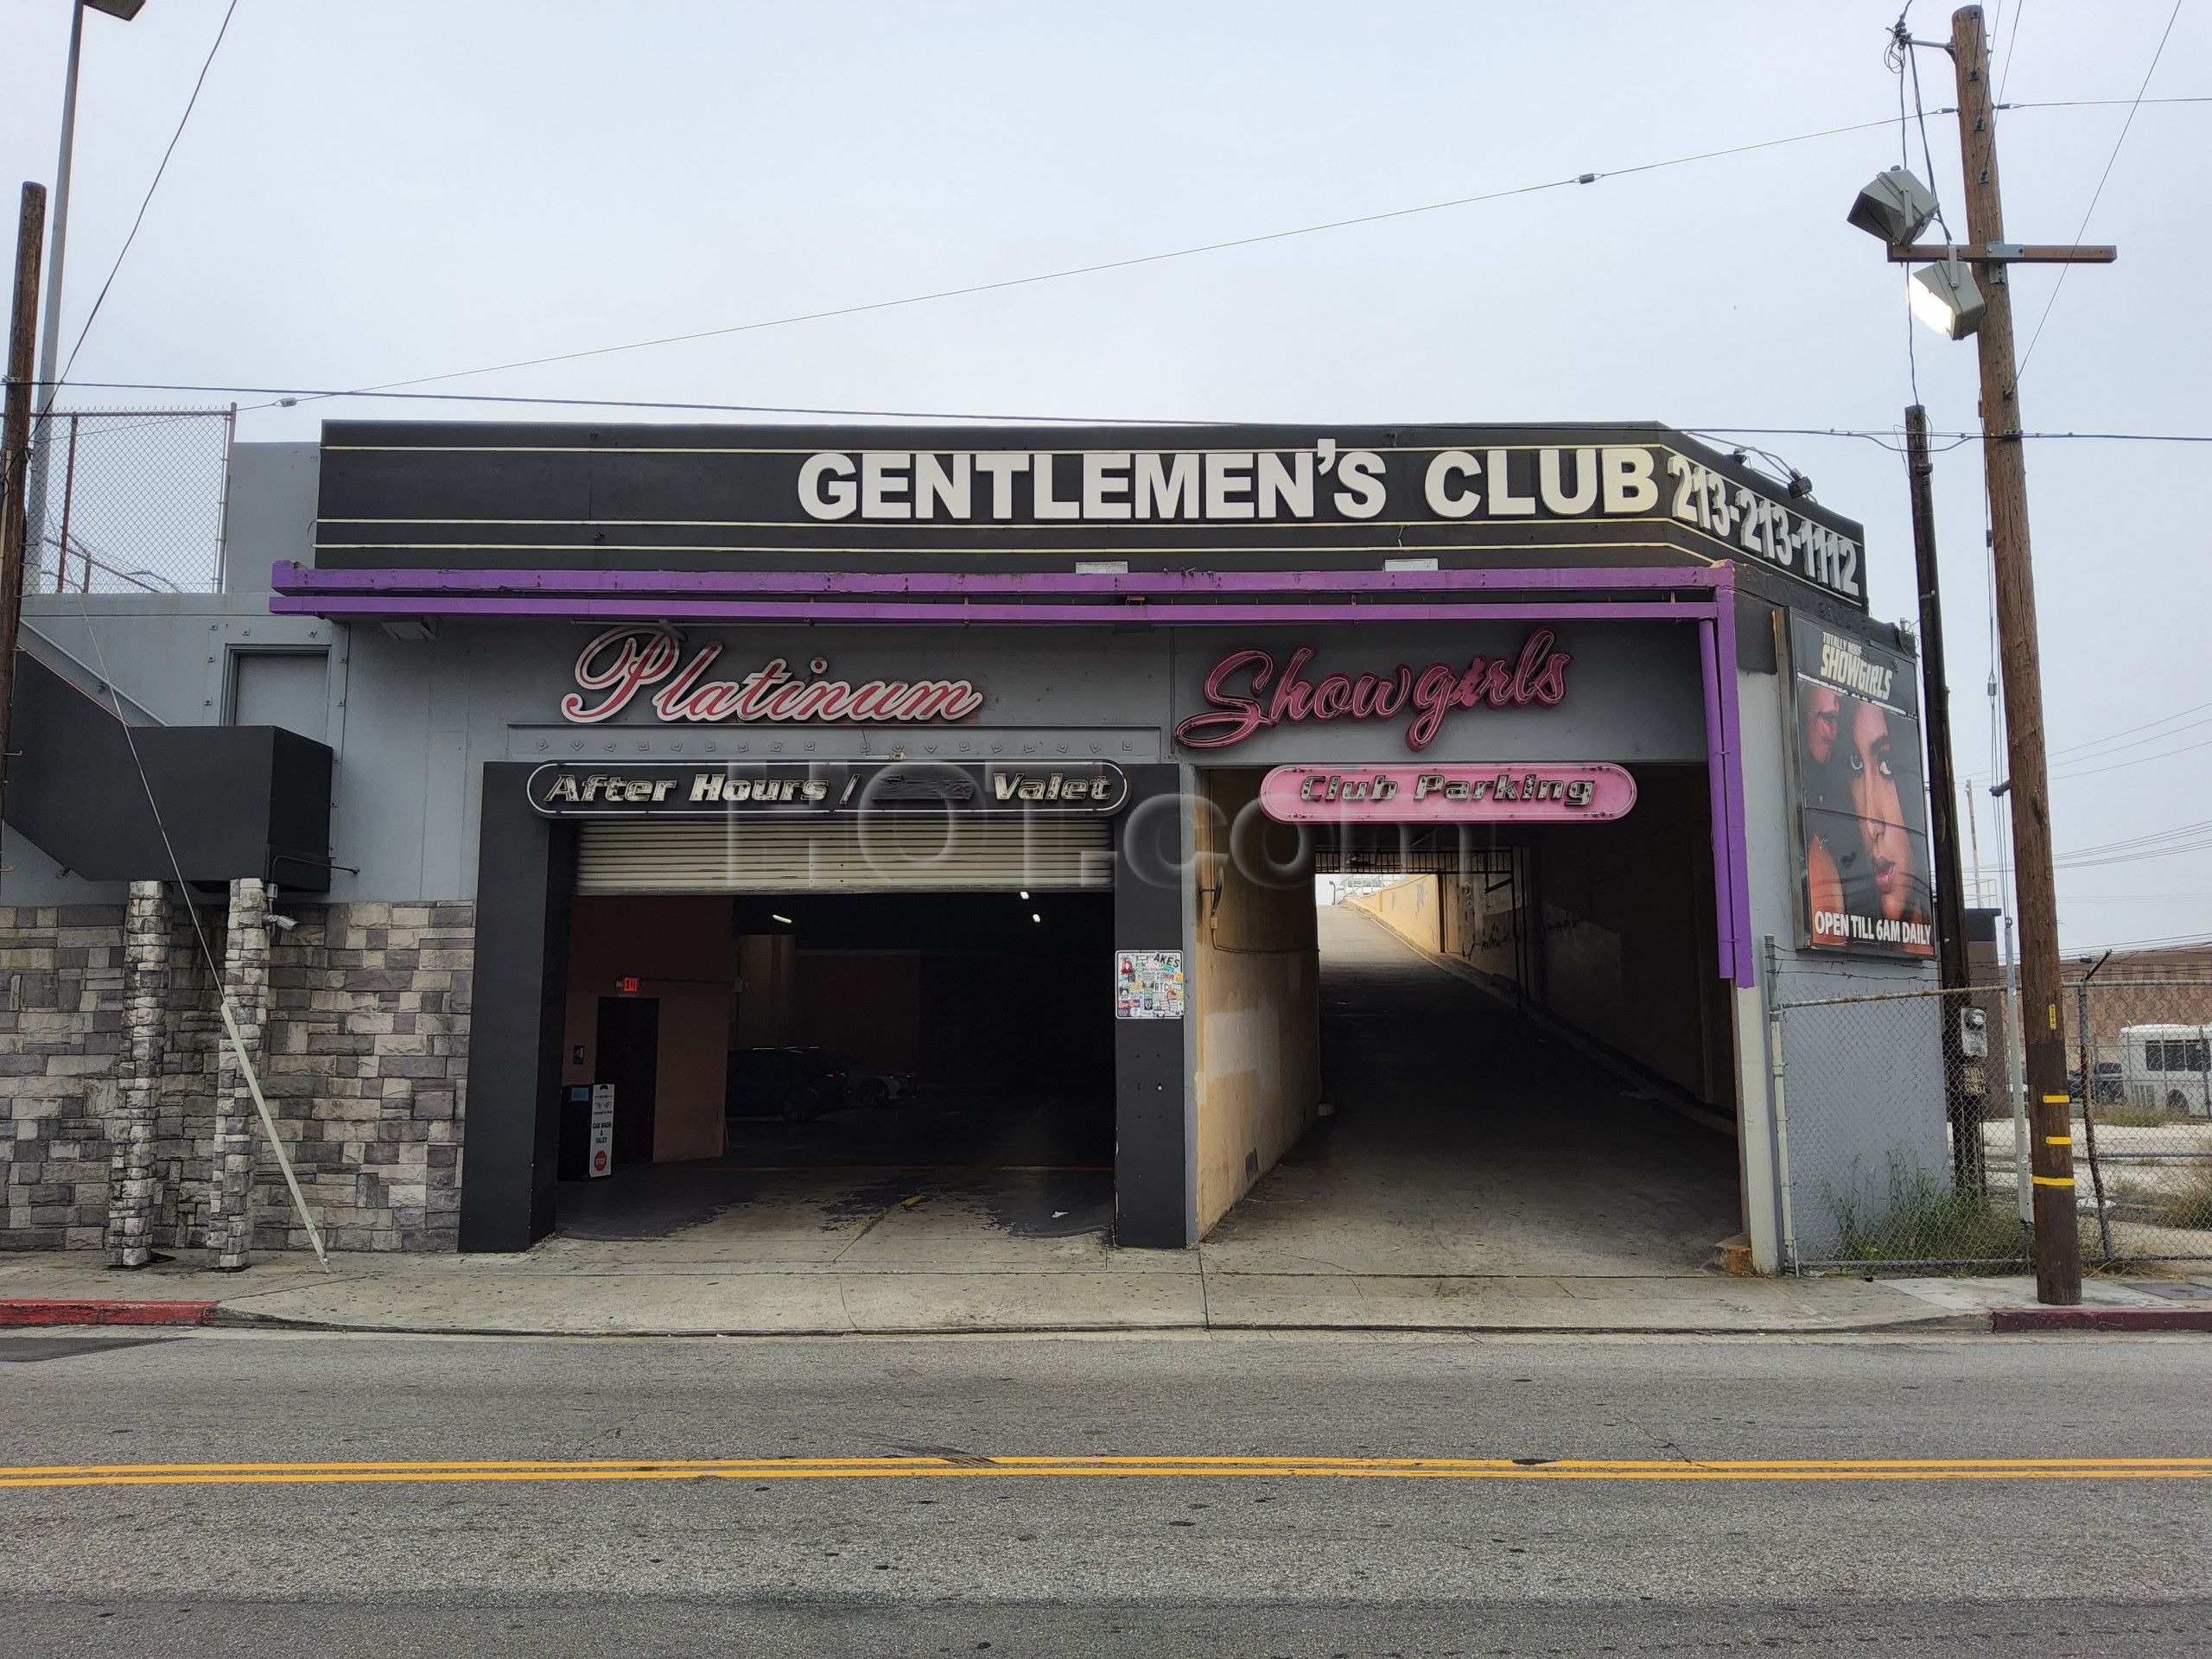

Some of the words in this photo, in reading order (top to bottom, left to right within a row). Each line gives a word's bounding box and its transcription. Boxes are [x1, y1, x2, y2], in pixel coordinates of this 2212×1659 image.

[798, 438, 1387, 519] GENTLEMEN'S
[1424, 447, 1659, 518] CLUB
[1667, 454, 1859, 597] 213-213-1112
[1822, 631, 1847, 651] TOTALLY
[561, 625, 983, 723] Platinum
[1173, 625, 1573, 751] Showgirls
[1821, 644, 1892, 701] SHOWGIRLS
[543, 774, 677, 803] After
[688, 773, 829, 802] Hours
[993, 772, 1111, 801] Valet
[1300, 775, 1398, 801] Club
[1412, 775, 1597, 806] Parking
[1815, 911, 1849, 937] OPEN
[1850, 915, 1874, 939] TILL
[1876, 919, 1900, 942] 6AM
[1902, 921, 1931, 944] DAILY
[624, 977, 637, 992] EXIT
